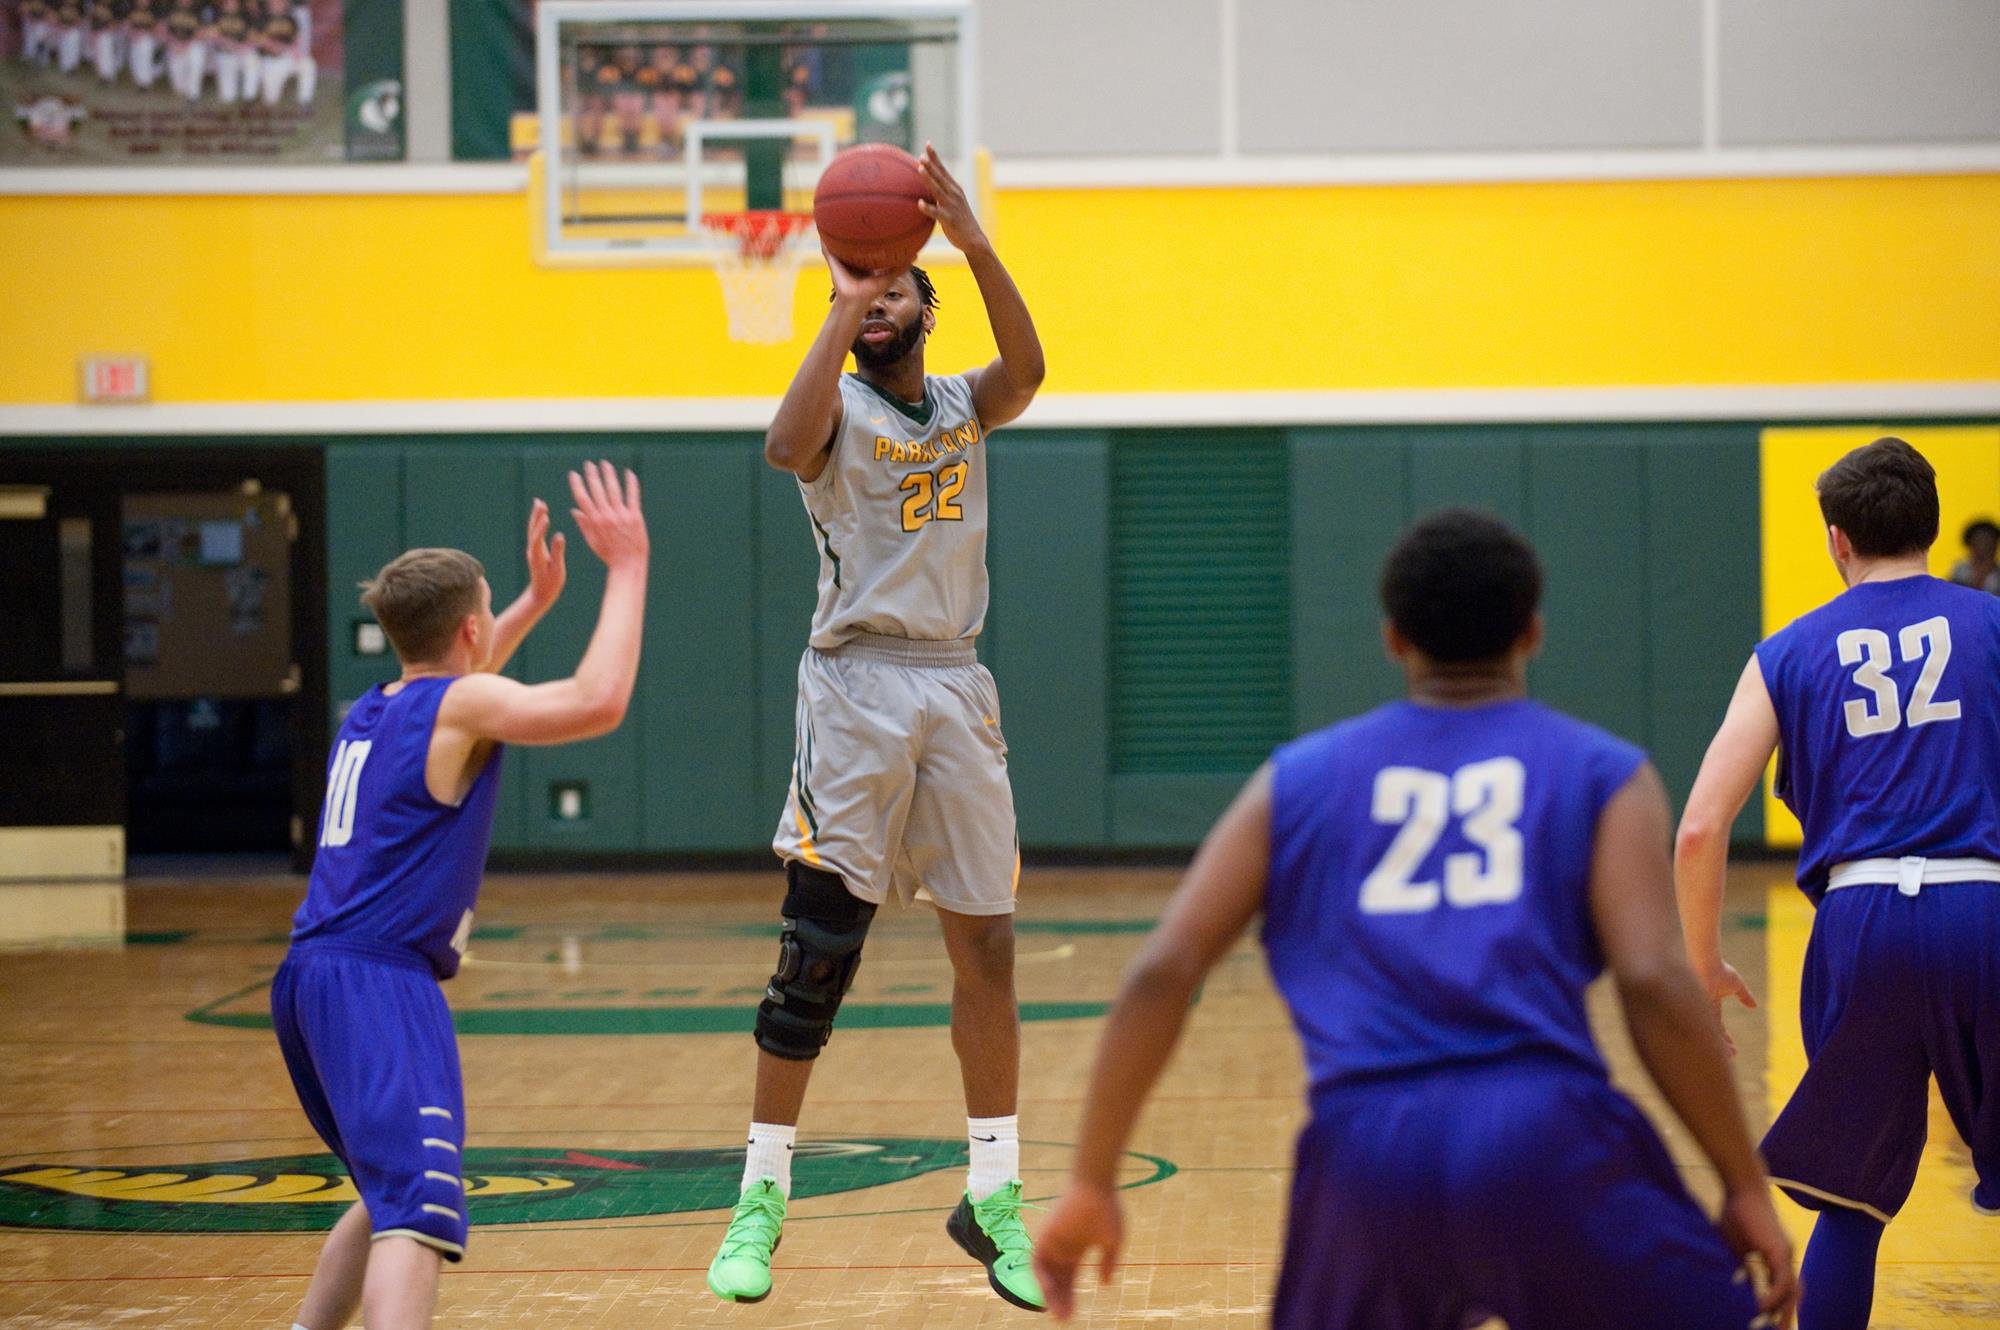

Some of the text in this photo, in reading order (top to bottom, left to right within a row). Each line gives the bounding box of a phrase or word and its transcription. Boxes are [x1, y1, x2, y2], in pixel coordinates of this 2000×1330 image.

[899, 459, 968, 532] 22
[1836, 615, 1962, 738] 32
[319, 739, 372, 848] 10
[1357, 756, 1526, 916] 23
